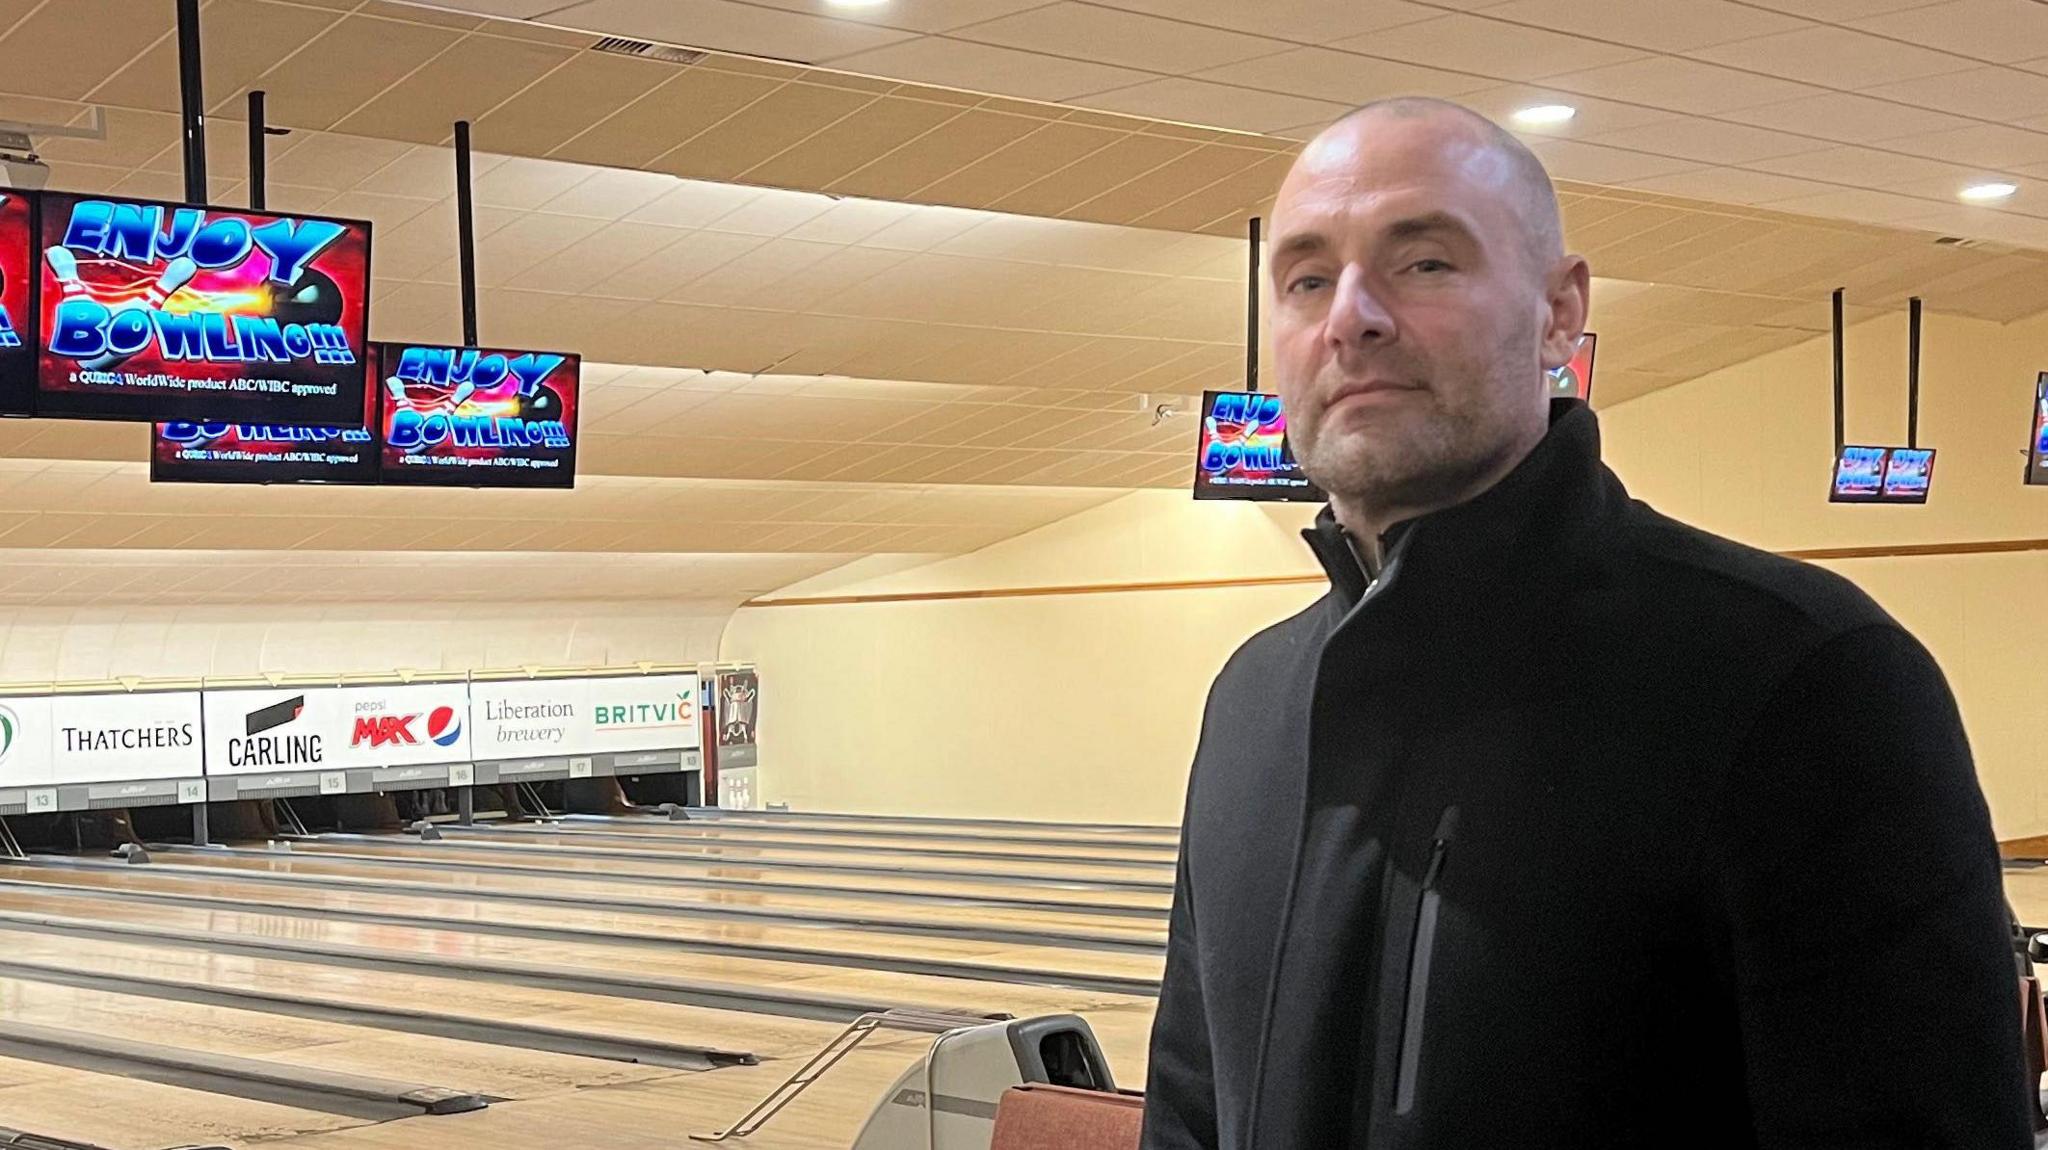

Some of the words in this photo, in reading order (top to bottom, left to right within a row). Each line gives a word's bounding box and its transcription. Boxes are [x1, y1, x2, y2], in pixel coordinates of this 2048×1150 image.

[63, 200, 347, 286] ENJOY
[49, 300, 356, 364] BOWLING!!!
[69, 373, 77, 383] a
[125, 373, 185, 388] WorldWide
[187, 376, 227, 391] product
[228, 378, 289, 393] ABC/WIBC
[291, 382, 337, 396] approved
[396, 347, 565, 397] ENJOY
[1212, 394, 1282, 424] ENJO
[387, 409, 570, 448] BOWLING!!!
[486, 699, 574, 721] Liberation
[595, 700, 692, 725] BRITVIC
[350, 713, 420, 748] MAX
[496, 724, 565, 744] brewery
[228, 734, 322, 767] CARLING
[186, 786, 198, 798] 14
[326, 777, 340, 789] 15
[35, 794, 48, 806] 13
